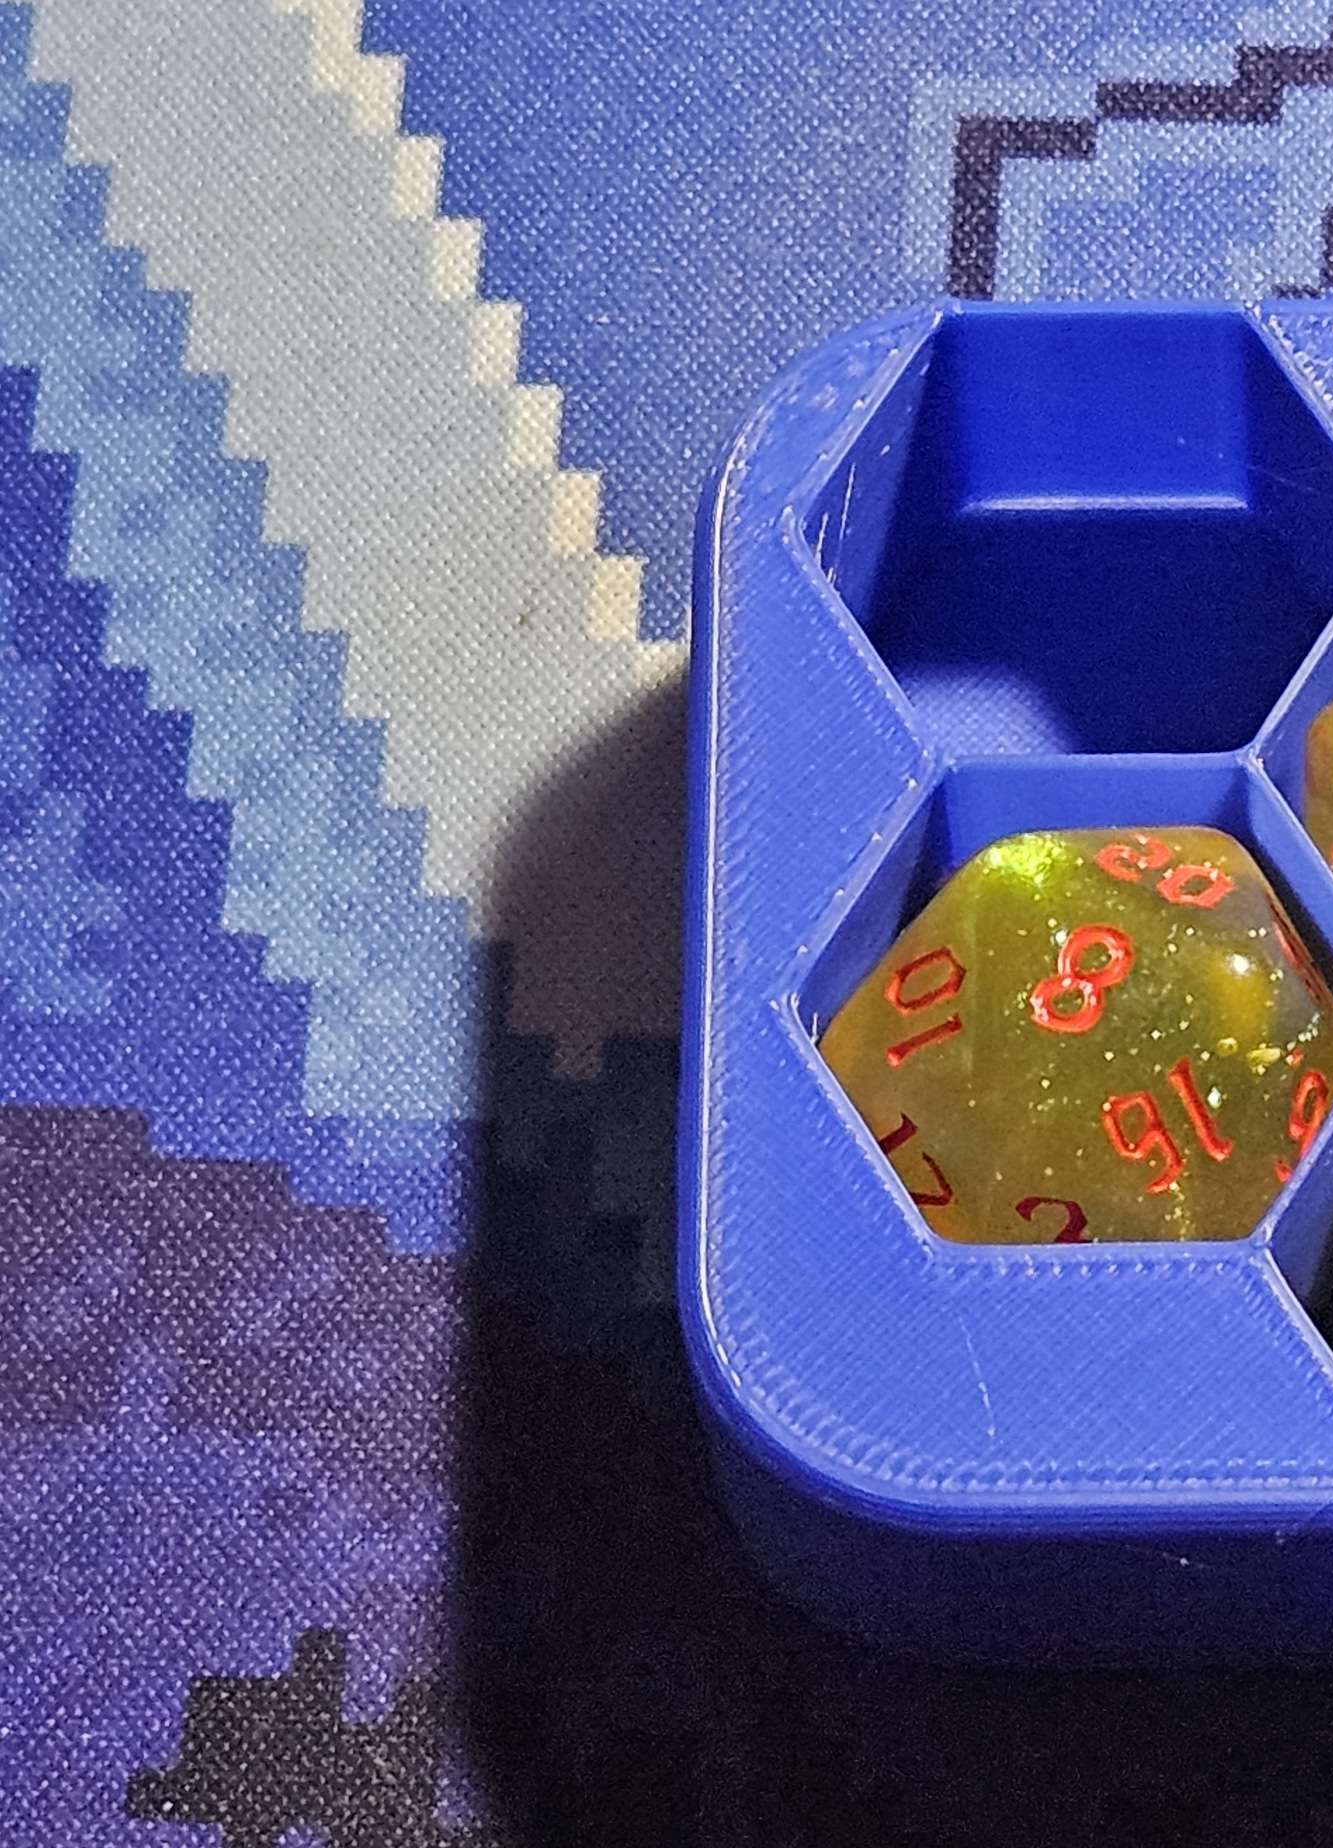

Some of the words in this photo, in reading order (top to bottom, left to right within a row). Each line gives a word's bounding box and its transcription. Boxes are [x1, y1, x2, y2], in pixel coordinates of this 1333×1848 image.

[1094, 832, 1236, 909] 20
[884, 946, 967, 1068] 10
[1029, 923, 1135, 1034] 8
